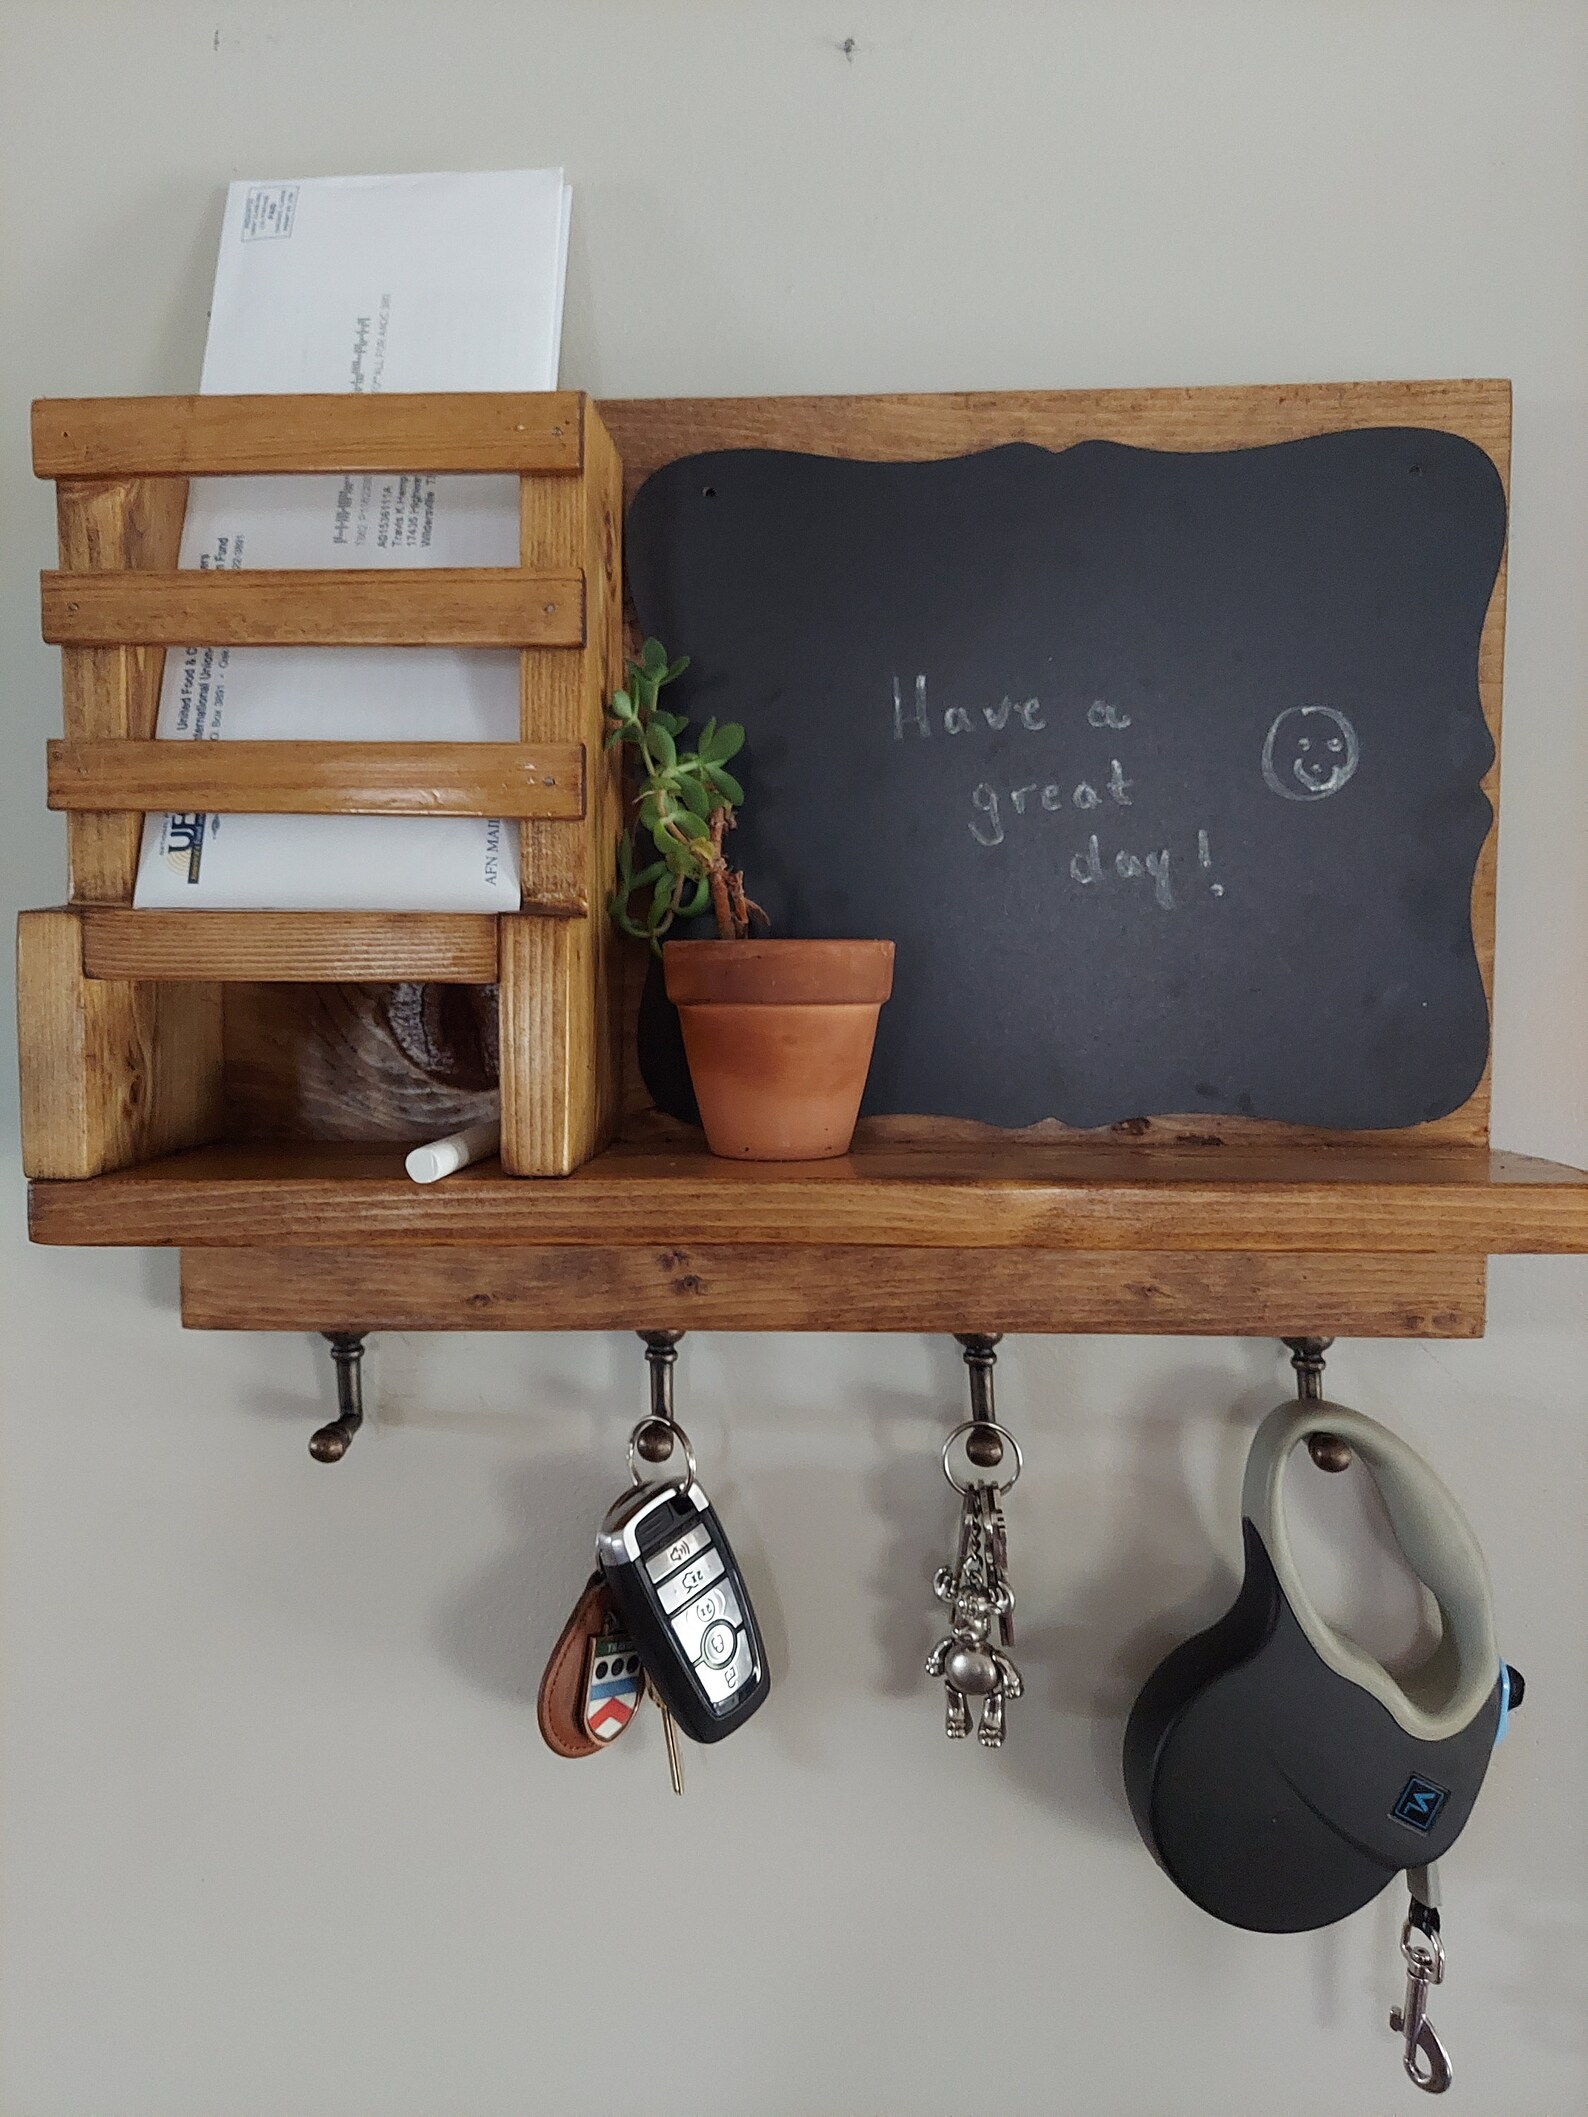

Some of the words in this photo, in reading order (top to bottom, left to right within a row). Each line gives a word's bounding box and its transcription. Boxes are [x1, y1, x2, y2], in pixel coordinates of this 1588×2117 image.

[181, 669, 195, 694] Food
[177, 697, 191, 731] United
[893, 674, 1047, 740] Have
[1087, 698, 1132, 731] a
[968, 758, 1134, 846] great
[485, 855, 498, 887] AFN
